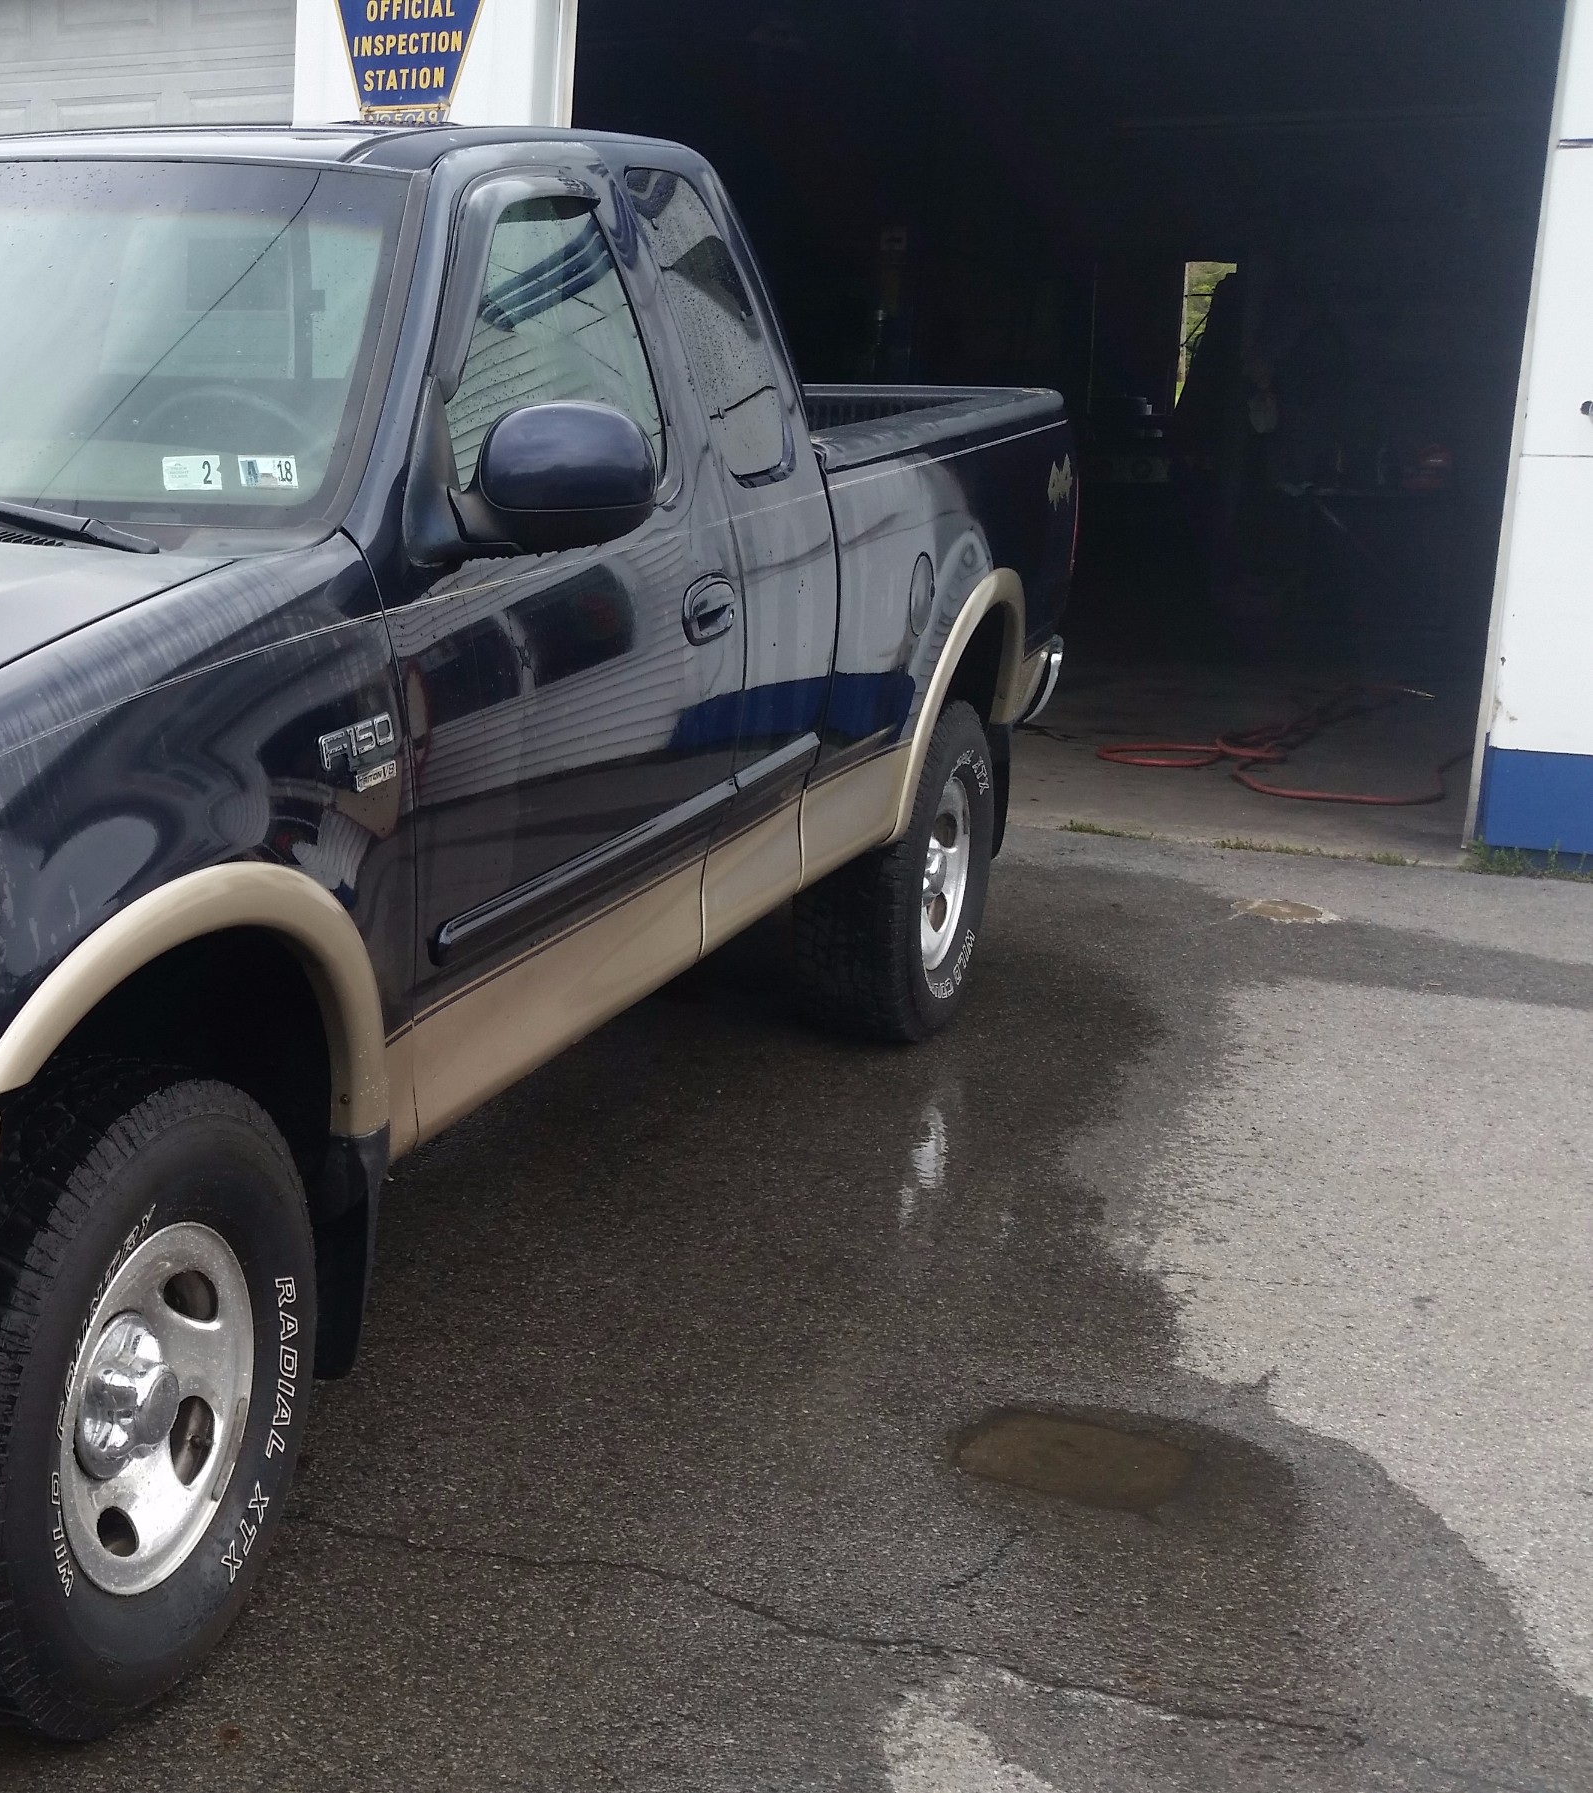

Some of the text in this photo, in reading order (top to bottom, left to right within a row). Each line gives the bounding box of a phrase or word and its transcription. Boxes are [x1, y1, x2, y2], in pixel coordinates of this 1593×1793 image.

[366, 0, 455, 22] OFFICIAL
[353, 30, 463, 57] INSPECTION
[363, 67, 445, 92] STATION
[202, 460, 213, 485] 2
[277, 460, 293, 482] 18
[265, 1276, 299, 1459] RADIAL
[51, 1472, 74, 1598] WILD
[221, 1480, 271, 1584] XTX
